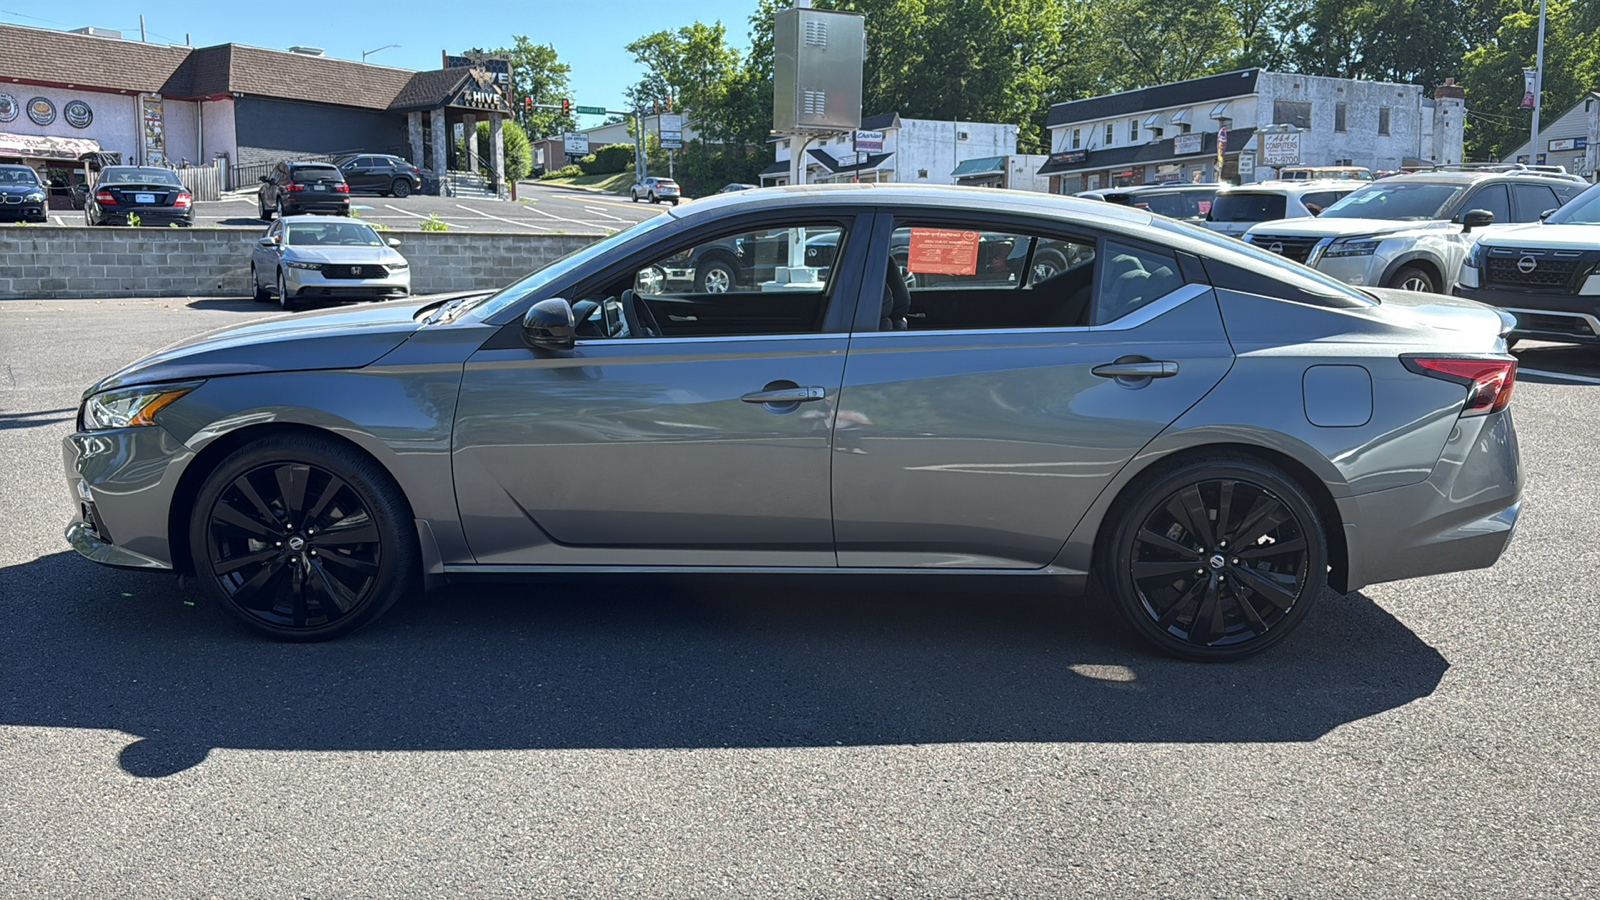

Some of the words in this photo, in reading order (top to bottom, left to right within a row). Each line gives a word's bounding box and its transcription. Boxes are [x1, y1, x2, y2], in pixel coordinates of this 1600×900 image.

[473, 91, 501, 105] HIVE
[1265, 141, 1298, 150] COMPUTERS
[1264, 156, 1299, 165] 942-9700
